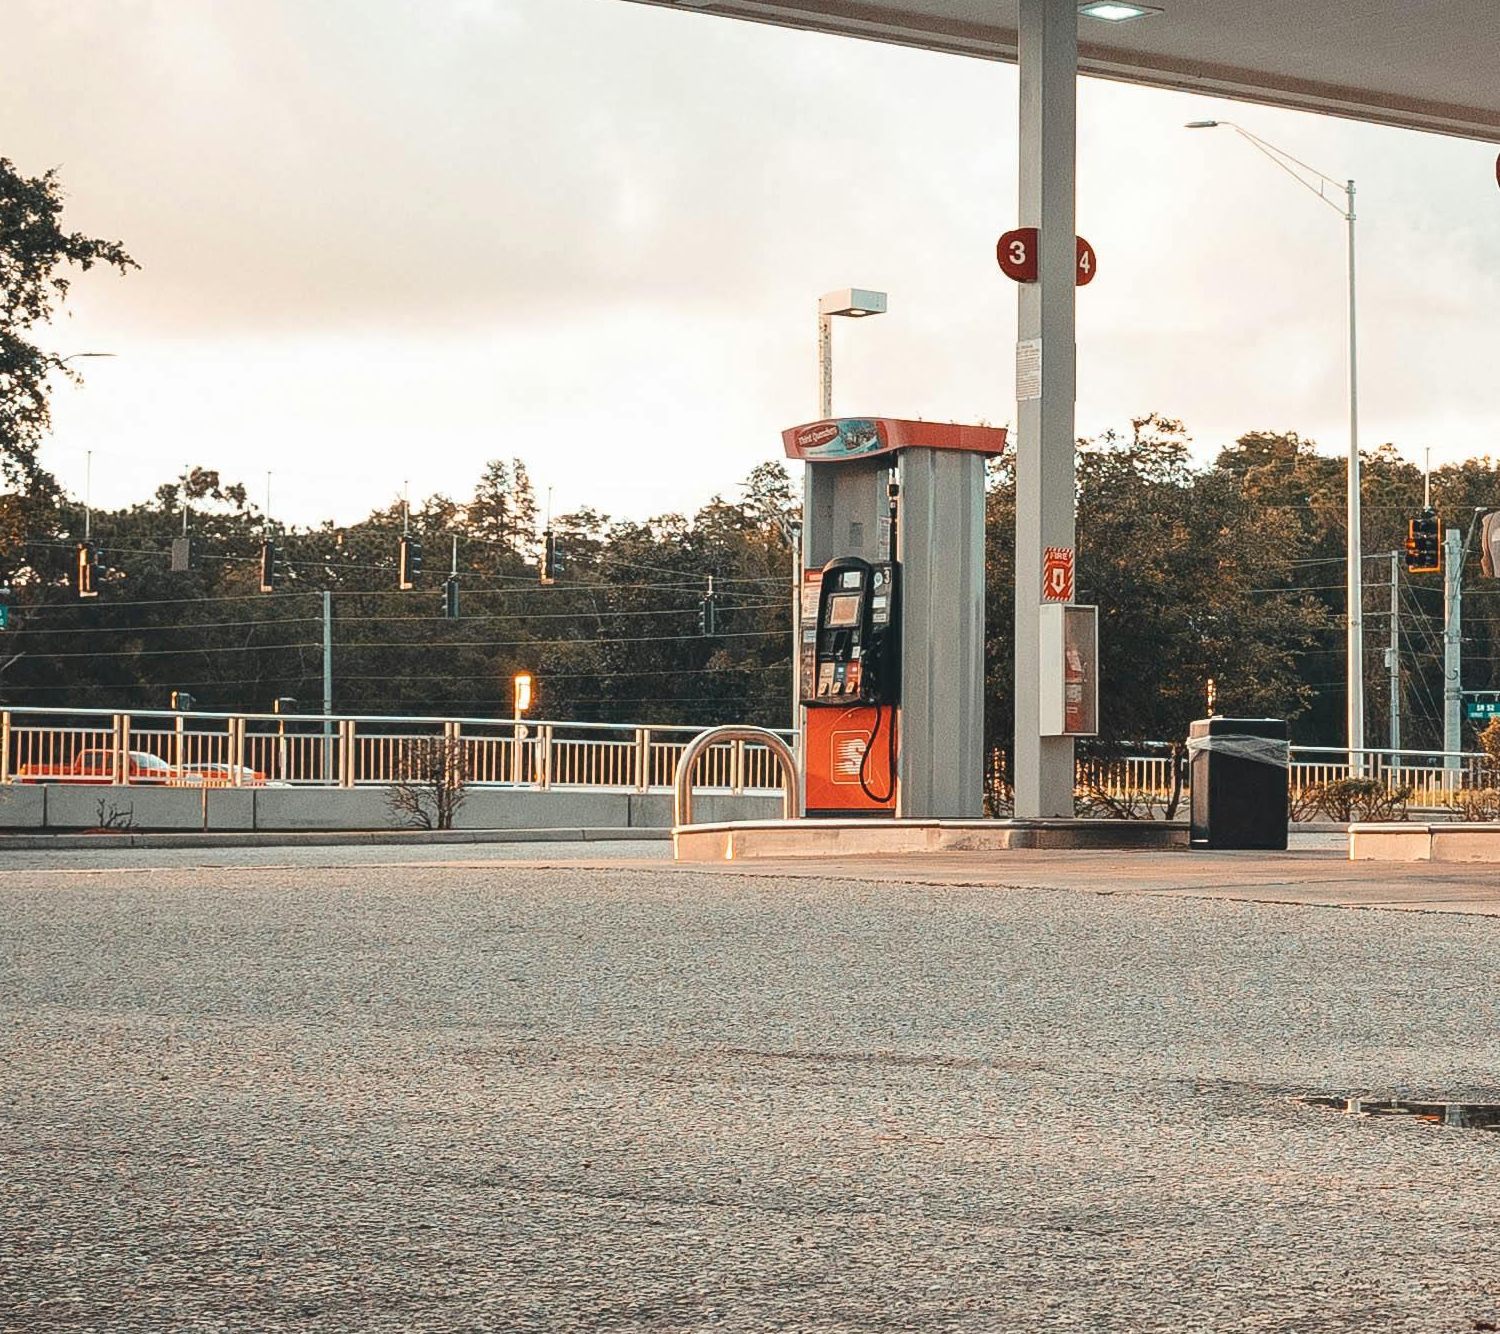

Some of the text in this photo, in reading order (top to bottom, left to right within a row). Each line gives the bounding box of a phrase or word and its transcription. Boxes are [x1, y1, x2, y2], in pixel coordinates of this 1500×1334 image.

[1009, 240, 1026, 265] 3
[1079, 250, 1091, 274] 4
[1050, 551, 1068, 561] FIRE
[884, 569, 891, 584] 3
